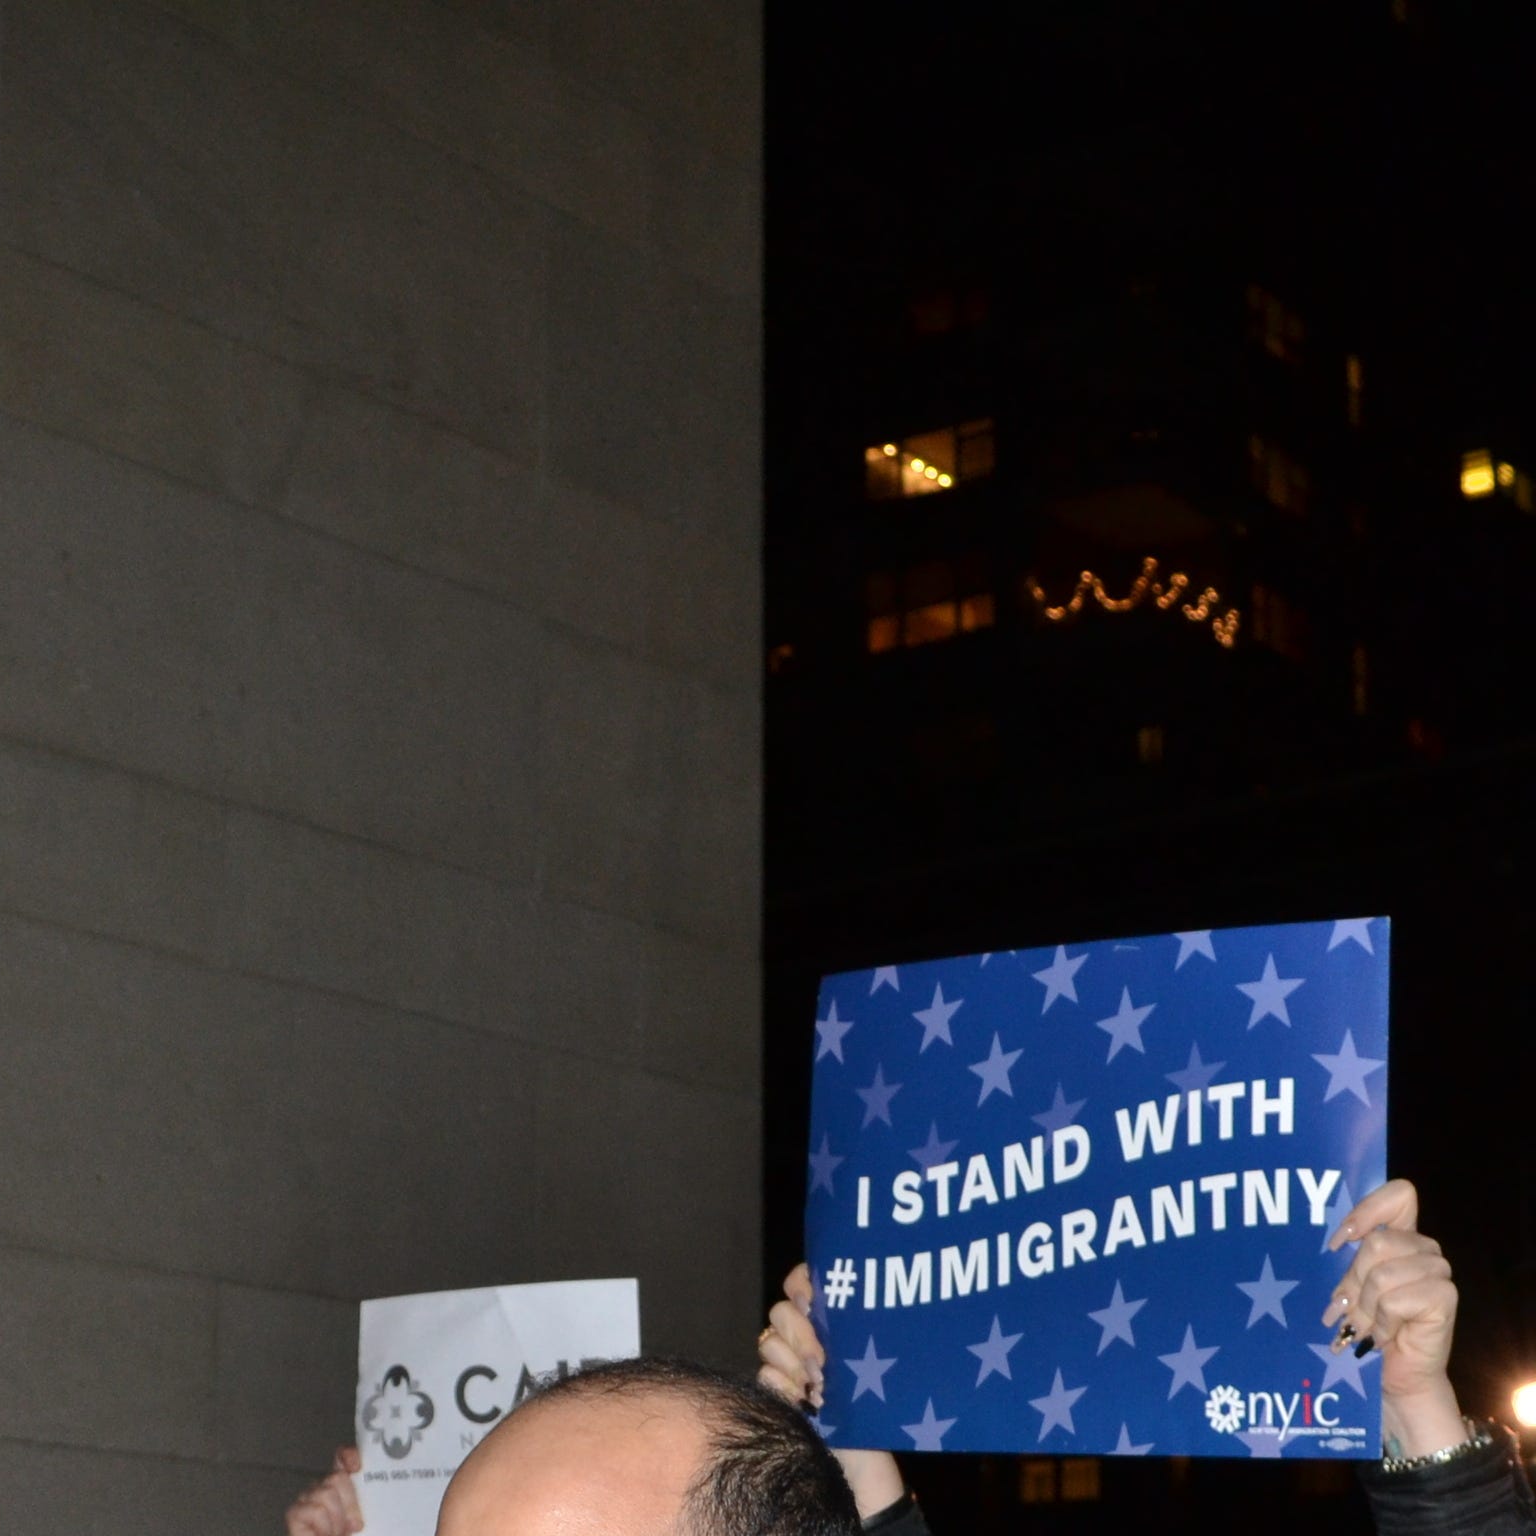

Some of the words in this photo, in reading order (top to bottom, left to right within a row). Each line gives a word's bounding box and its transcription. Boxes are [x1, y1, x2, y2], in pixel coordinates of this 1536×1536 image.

[856, 1176, 870, 1228] I
[892, 1125, 1091, 1224] STAND
[1115, 1077, 1295, 1162] WITH
[824, 1168, 1341, 1309] #IMMIGRANTNY
[1249, 1378, 1340, 1441] nyic
